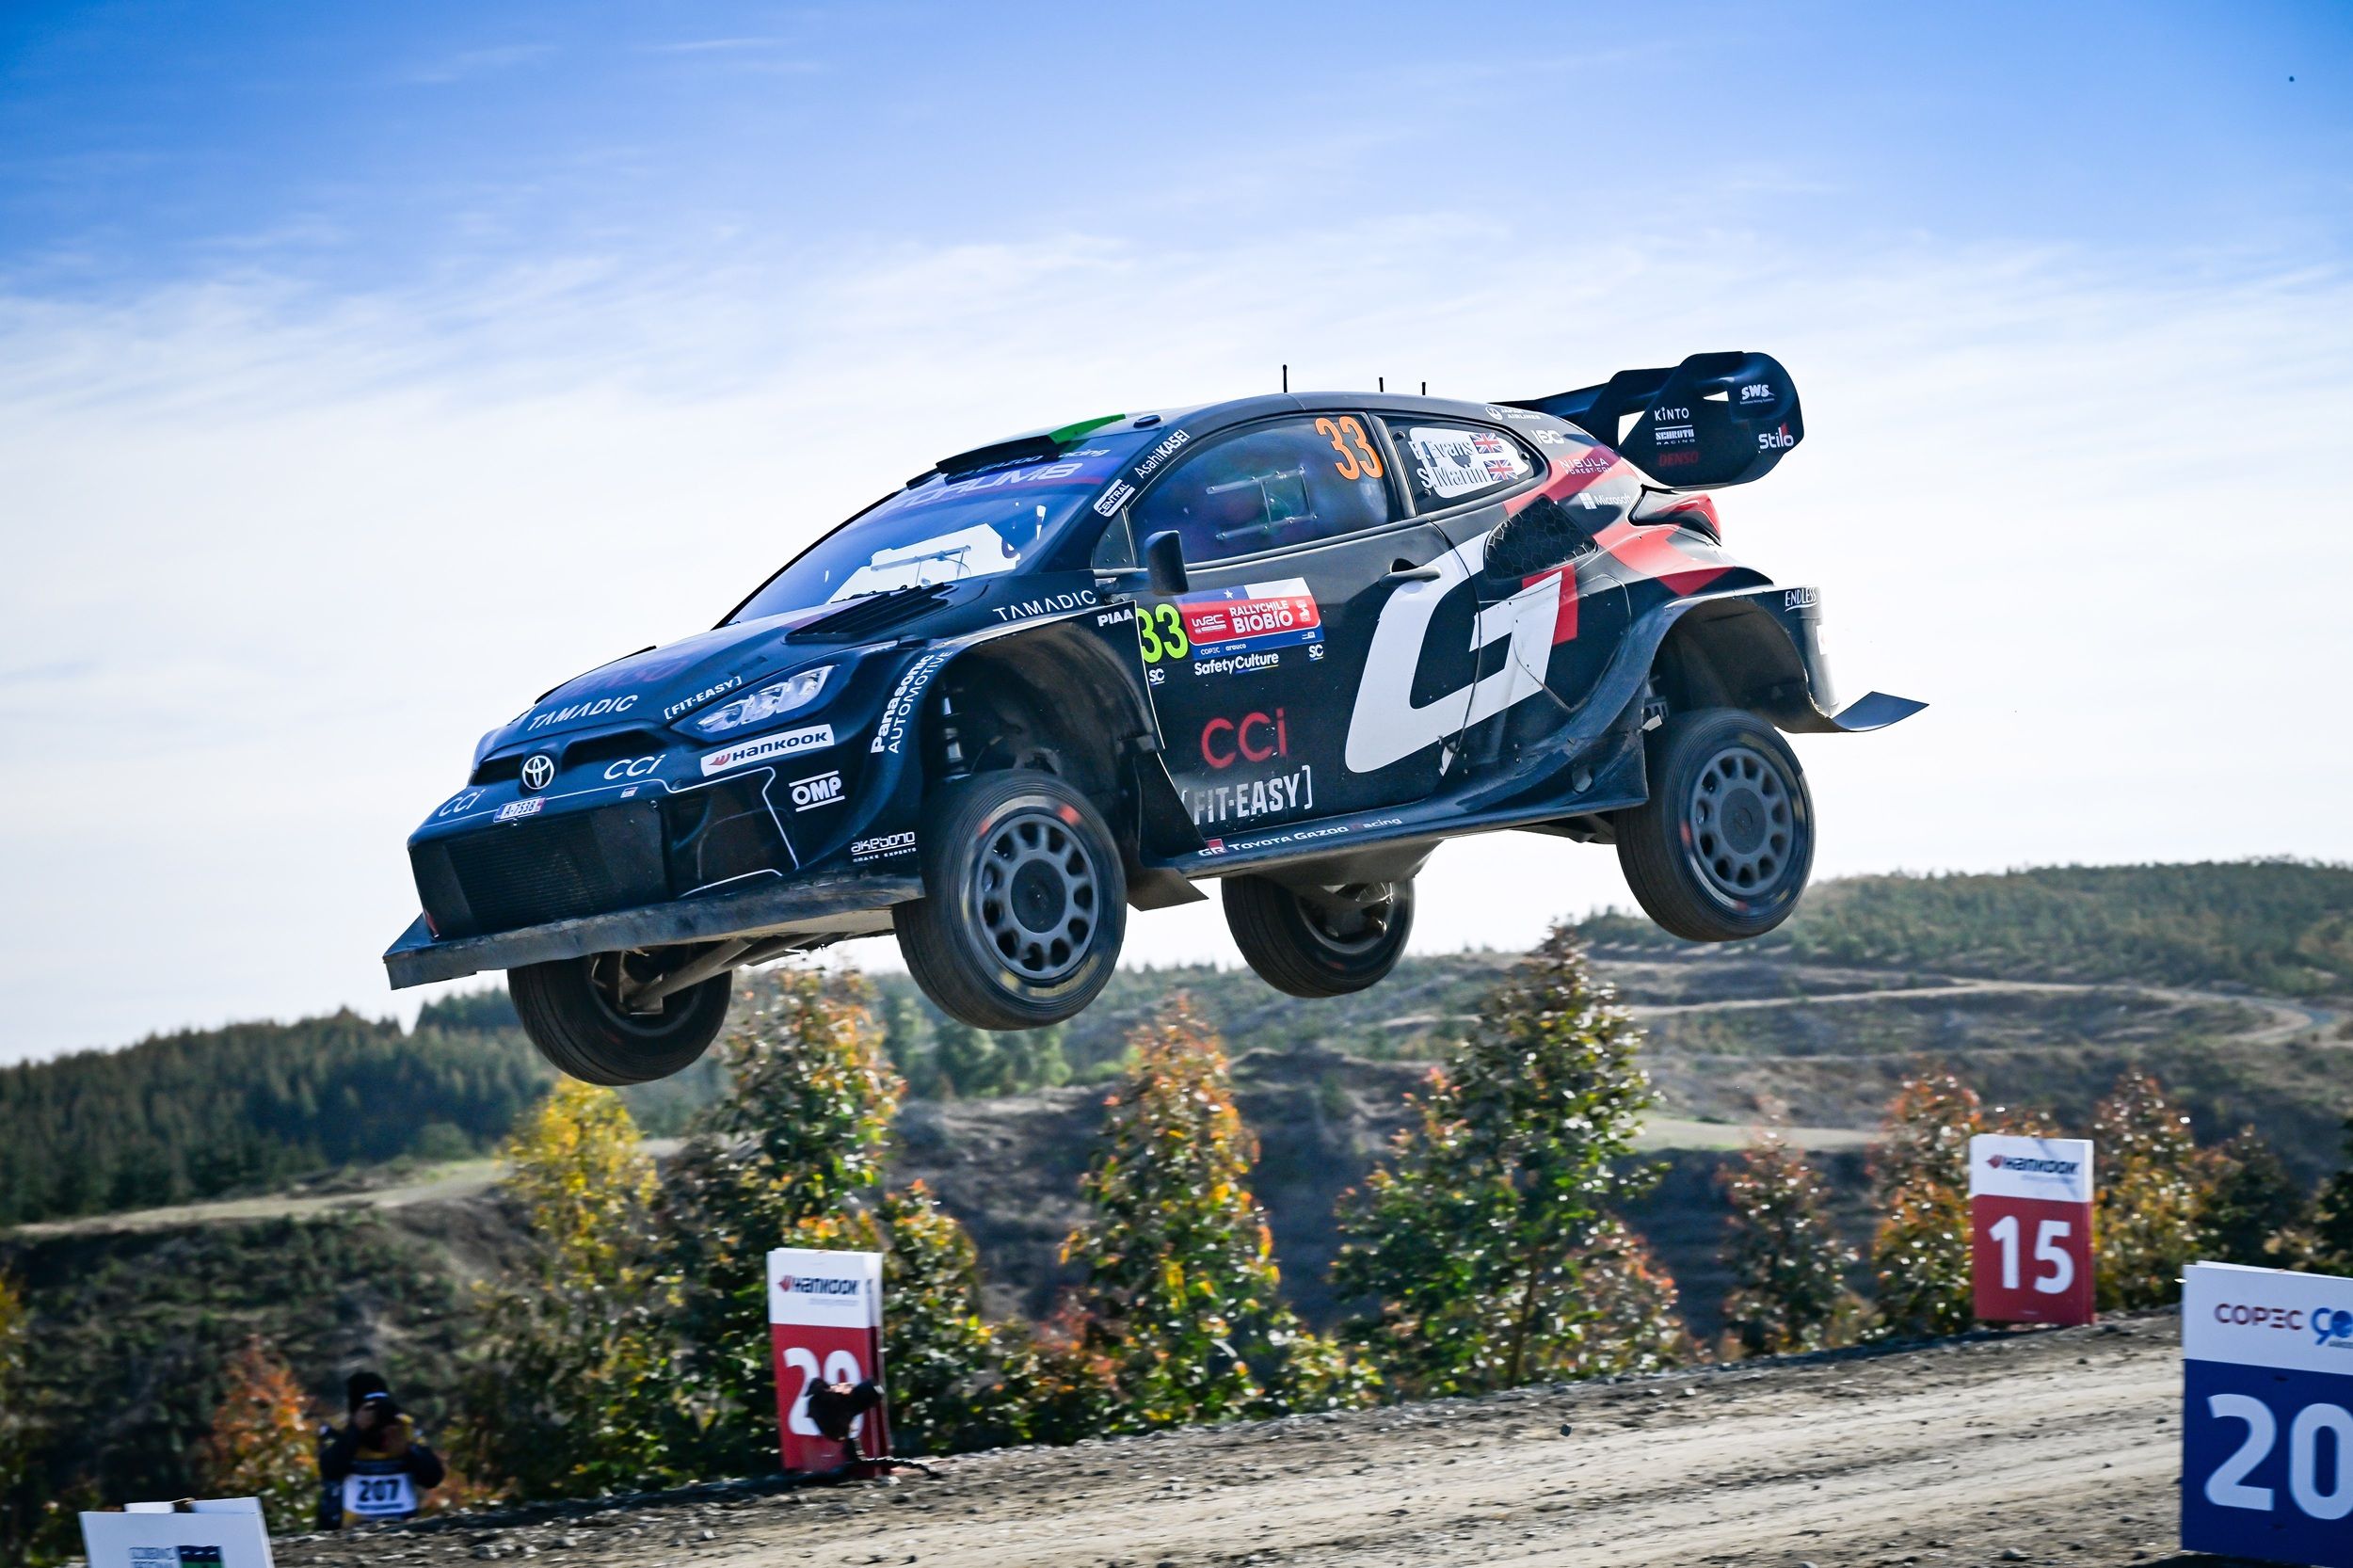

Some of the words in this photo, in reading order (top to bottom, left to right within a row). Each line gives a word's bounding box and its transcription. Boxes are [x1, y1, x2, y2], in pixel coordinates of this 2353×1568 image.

[1741, 384, 1769, 400] SWS
[1654, 407, 1689, 421] KINTO
[1656, 429, 1695, 440] SCHROTH
[1758, 425, 1795, 450] Stilo
[1315, 415, 1385, 480] 33
[1559, 457, 1610, 470] NISULA
[1097, 483, 1130, 515] CENTRAL
[992, 589, 1096, 621] TAMADIC
[1785, 587, 1817, 607] ENDLESS
[1096, 608, 1134, 627] PIAA
[1191, 614, 1225, 628] WRC
[1137, 603, 1189, 664] 33
[1200, 647, 1221, 656] COPEC
[1308, 644, 1324, 658] SC
[1148, 668, 1165, 682] SC
[1194, 652, 1279, 676] SafetyCulture
[527, 695, 638, 731] TAMADIC
[870, 654, 936, 753] Panasonic
[888, 651, 953, 754] AUTOMOTIVE
[792, 776, 842, 802] OMP
[1228, 836, 1292, 852] TOYOTA
[1988, 1215, 2074, 1294] 15
[2215, 1303, 2303, 1331] COPEC
[2204, 1393, 2353, 1520] 20
